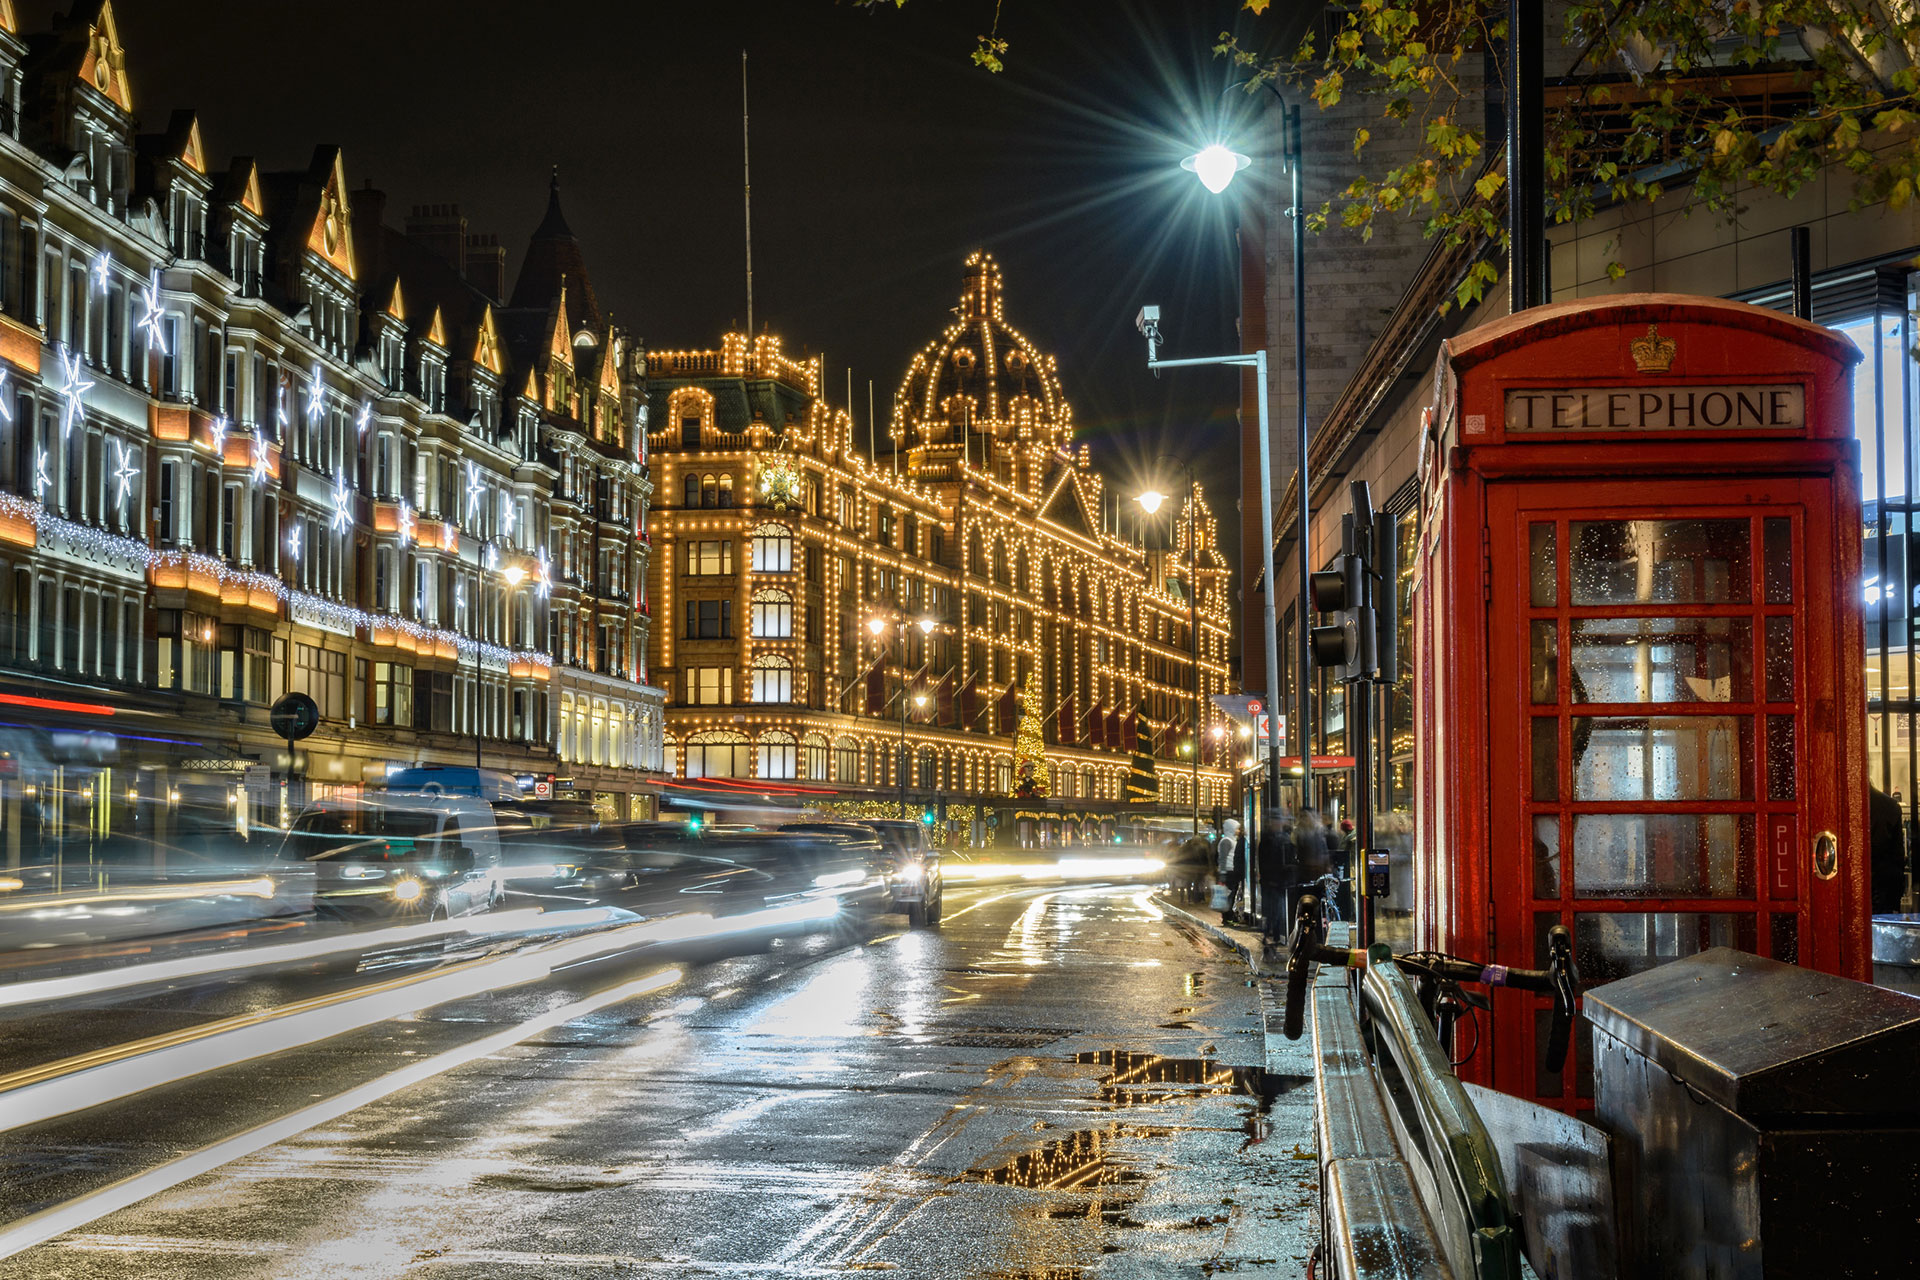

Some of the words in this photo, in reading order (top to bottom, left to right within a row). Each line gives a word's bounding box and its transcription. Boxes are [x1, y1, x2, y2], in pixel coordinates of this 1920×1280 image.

[1515, 391, 1793, 428] TELEPHONE
[1248, 704, 1260, 712] KD
[1776, 825, 1788, 888] PULL
